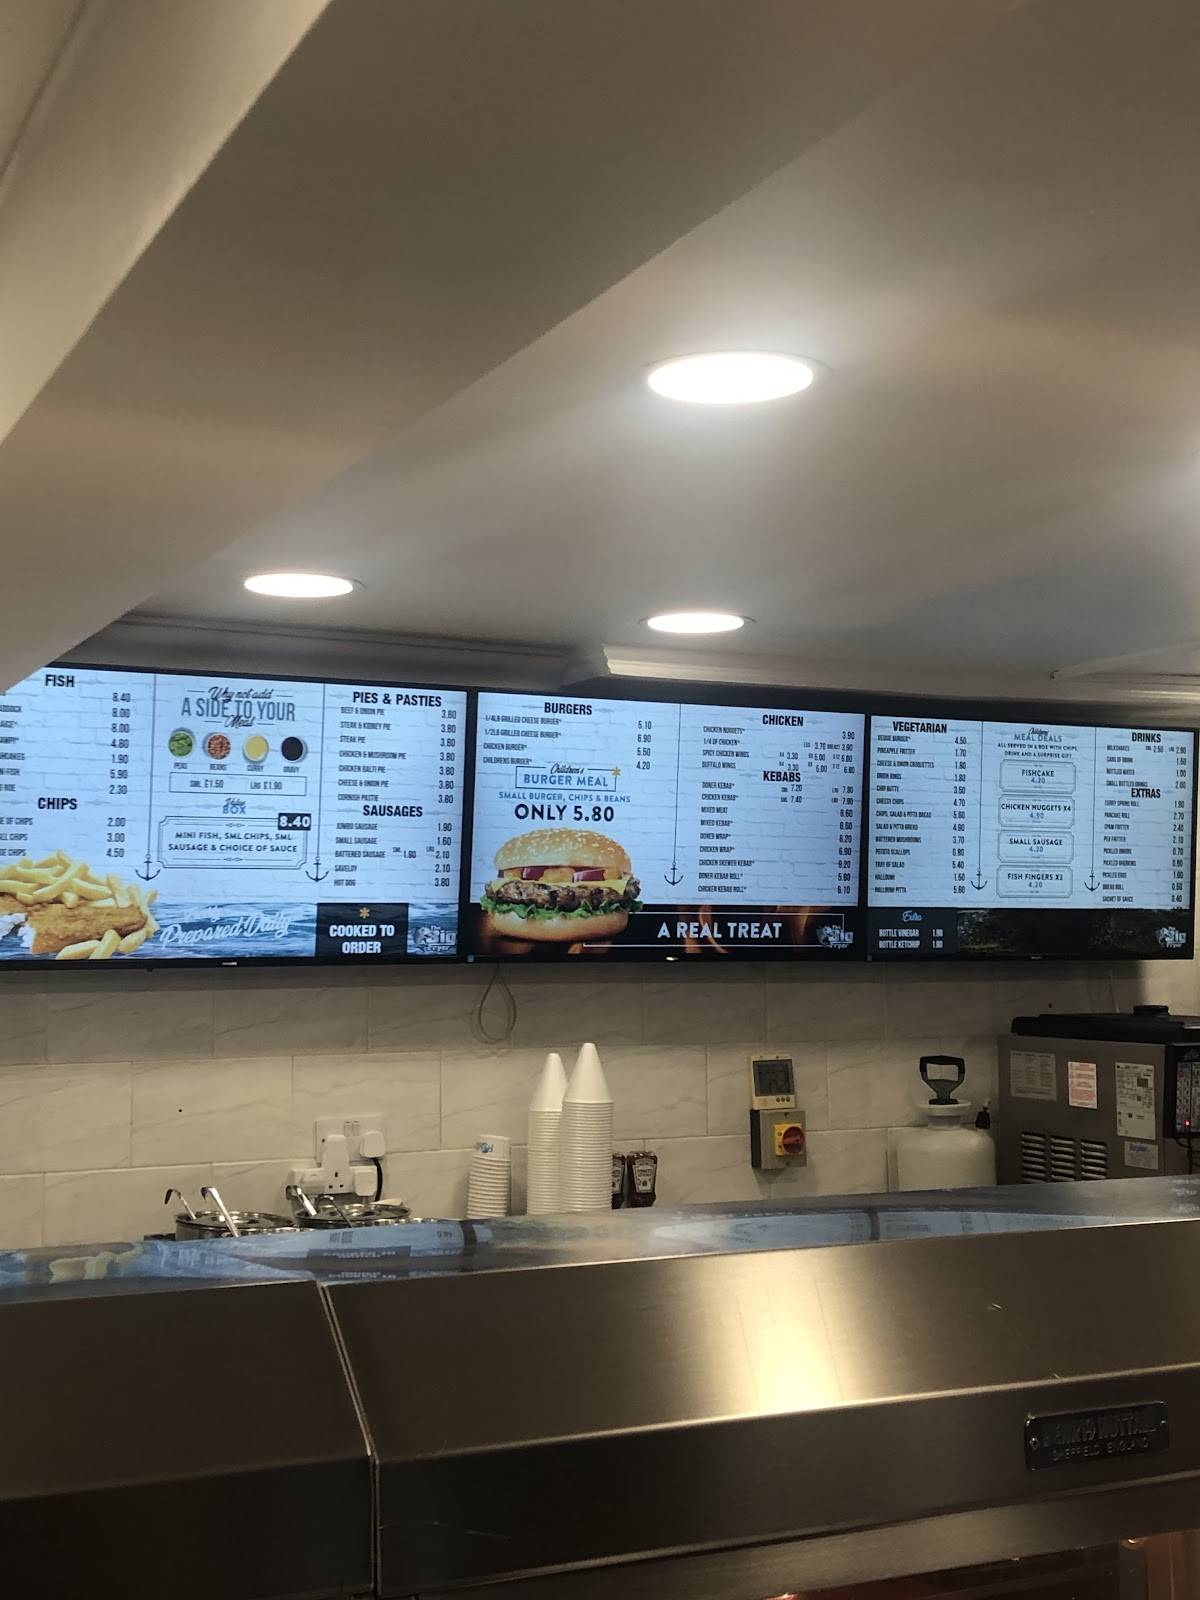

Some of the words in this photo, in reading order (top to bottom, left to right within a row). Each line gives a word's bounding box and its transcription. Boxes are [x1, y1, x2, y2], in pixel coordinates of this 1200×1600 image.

[45, 674, 75, 687] FISH
[112, 693, 131, 702] 8.40
[353, 692, 378, 703] PIES
[383, 693, 392, 704] &
[396, 694, 442, 707] PASTIES
[112, 708, 130, 718] 8.00
[182, 698, 191, 716] A
[196, 698, 229, 717] SIDE
[236, 701, 252, 718] TO
[257, 702, 295, 721] YOUR
[544, 702, 592, 715] BURGERS
[638, 721, 652, 729] 5.10
[763, 715, 803, 727] CHICKEN
[111, 723, 129, 733] 8.00
[893, 721, 947, 733] VEGETARIAN
[637, 735, 651, 743] 6.90
[842, 731, 855, 739] 3.90
[1132, 732, 1161, 743] DRINKS
[637, 748, 651, 756] 5.50
[955, 749, 966, 757] 1.70
[112, 755, 128, 764] 1.90
[636, 761, 650, 770] 4.20
[110, 770, 128, 779] 5.90
[763, 771, 801, 783] KEBABS
[204, 780, 224, 788] £1.50
[524, 774, 572, 785] BURGER
[577, 776, 608, 787] MEAL
[109, 785, 127, 794] 2.30
[264, 782, 282, 790] £1.90
[499, 792, 526, 800] SMALL
[1132, 788, 1160, 798] EXTRAS
[38, 797, 77, 810] CHIPS
[223, 806, 246, 815] BOX
[363, 805, 423, 817] SAUSAGES
[514, 803, 567, 820] ONLY
[573, 806, 614, 821] 5.80
[108, 818, 125, 827] 2.00
[279, 816, 311, 827] 8.40
[438, 823, 452, 832] 1.90
[953, 823, 965, 831] 4.90
[107, 833, 125, 843] 3.00
[952, 836, 964, 844] 3.70
[106, 848, 124, 857] 4.50
[436, 851, 449, 859] 2.10
[435, 864, 450, 872] 2.10
[954, 873, 965, 881] 1.50
[434, 878, 449, 887] 3.80
[837, 886, 850, 894] 6.10
[329, 926, 376, 937] COOKED
[380, 926, 394, 936] TO
[658, 923, 670, 938] A
[677, 923, 722, 939] REAL
[727, 923, 782, 939] TREAT
[342, 942, 381, 954] ORDER
